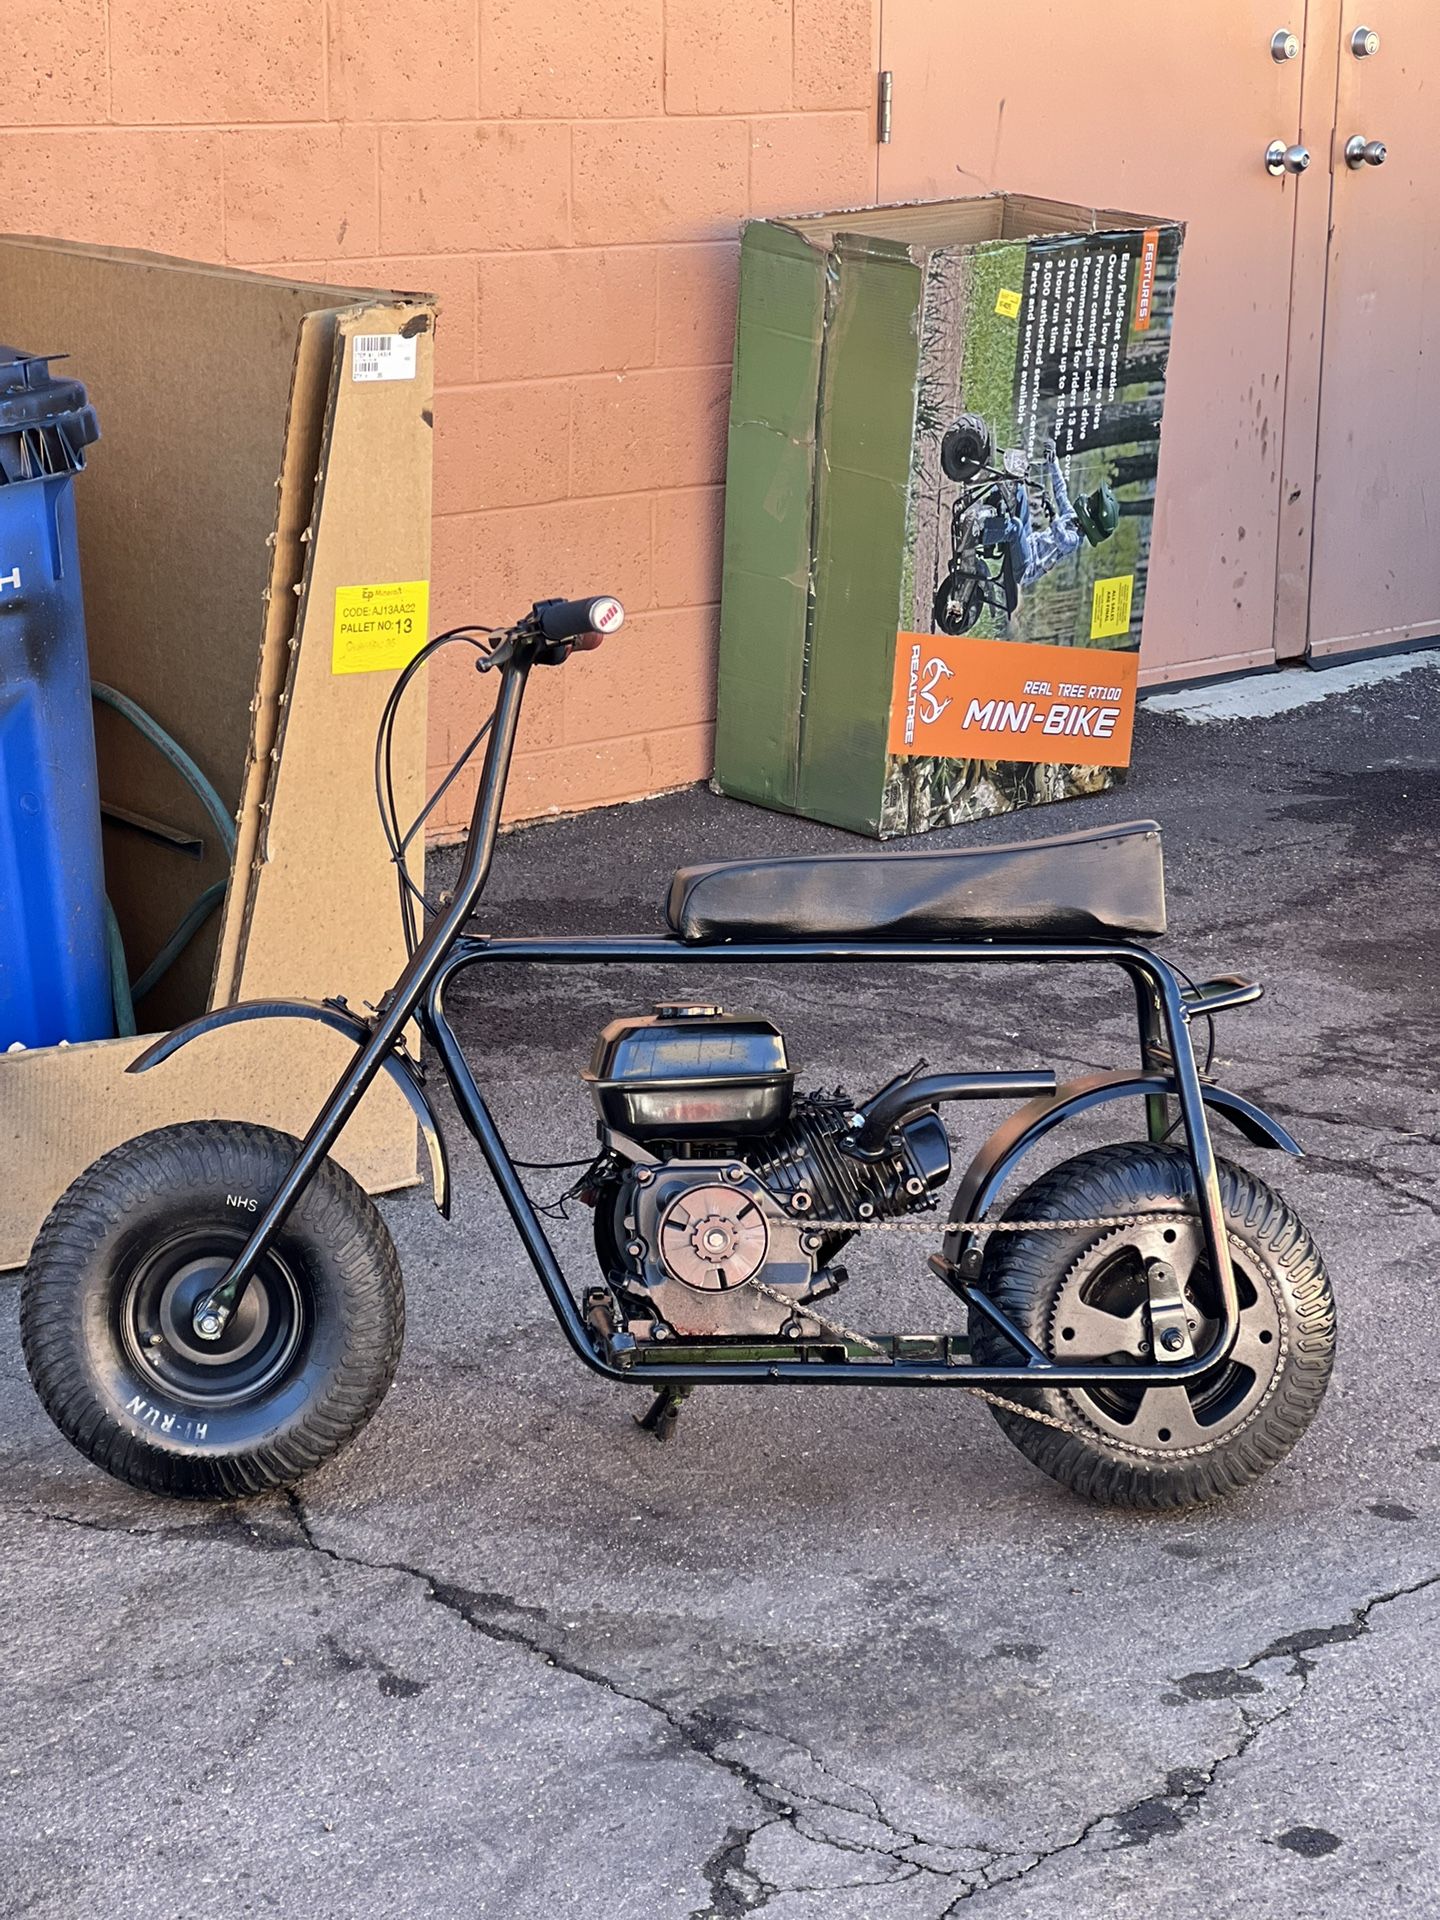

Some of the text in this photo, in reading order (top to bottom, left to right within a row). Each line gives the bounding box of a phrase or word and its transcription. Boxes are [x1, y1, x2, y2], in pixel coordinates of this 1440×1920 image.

[1049, 259, 1066, 354] 3 hour run time
[1108, 253, 1130, 402] Easy Pull-Start operation
[1139, 243, 1154, 321] FEATURES:
[1017, 262, 1040, 424] Parts and service available
[1027, 260, 1053, 459] 8,000 authorized service centers
[1054, 258, 1079, 440] Great for riders up to 150 lbs.
[1064, 256, 1092, 481] Recommended for riders 13 and over
[1080, 255, 1104, 440] Proven centrifugal clutch drive
[1093, 254, 1117, 430] Oversized, low pressure tires
[340, 618, 413, 635] PALLET NO: 13
[343, 607, 371, 618] CODE:
[904, 645, 920, 744] REALTREE
[961, 698, 1121, 738] MINI-BIKE
[1023, 681, 1122, 701] REAL TREE RT100
[226, 1194, 258, 1212] NHS
[125, 1395, 208, 1440] HI-RUN
